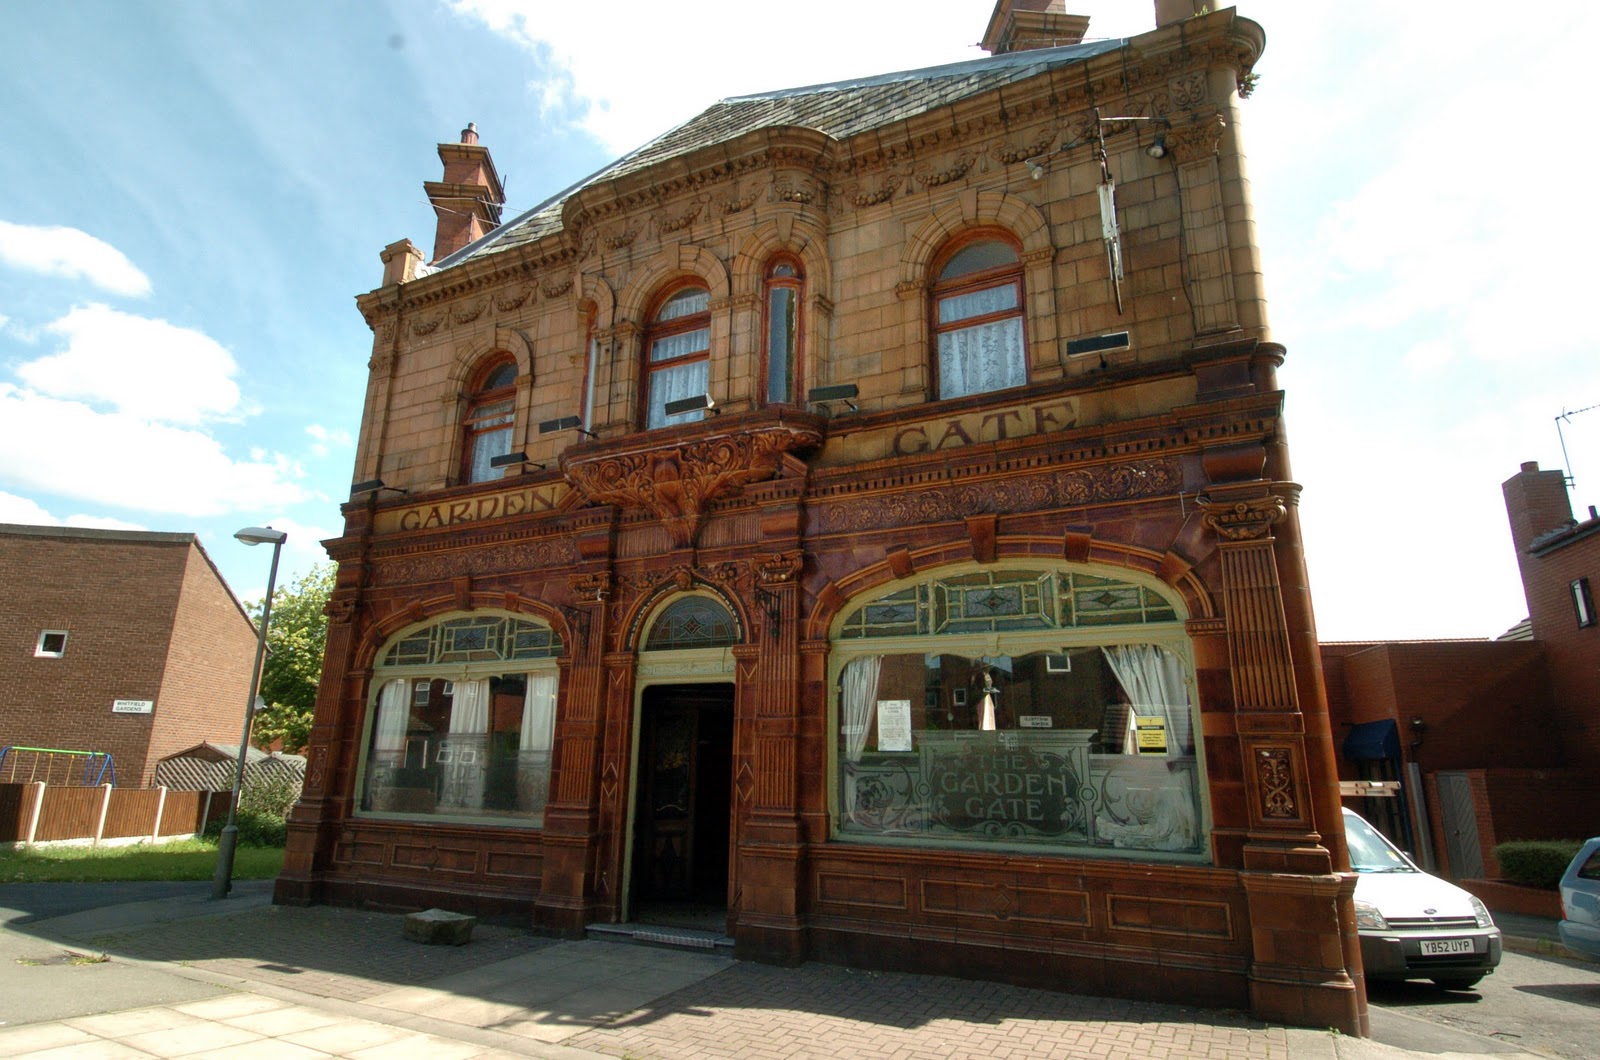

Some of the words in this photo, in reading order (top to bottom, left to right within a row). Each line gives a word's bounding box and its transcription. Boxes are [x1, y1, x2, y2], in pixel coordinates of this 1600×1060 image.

[892, 400, 1078, 457] GATE
[400, 487, 559, 531] GARDEN
[975, 754, 1028, 770] THE
[940, 772, 1067, 796] GARDEN
[965, 797, 1044, 821] GATE
[1424, 941, 1450, 953] YB52
[1451, 940, 1470, 952] UYP
